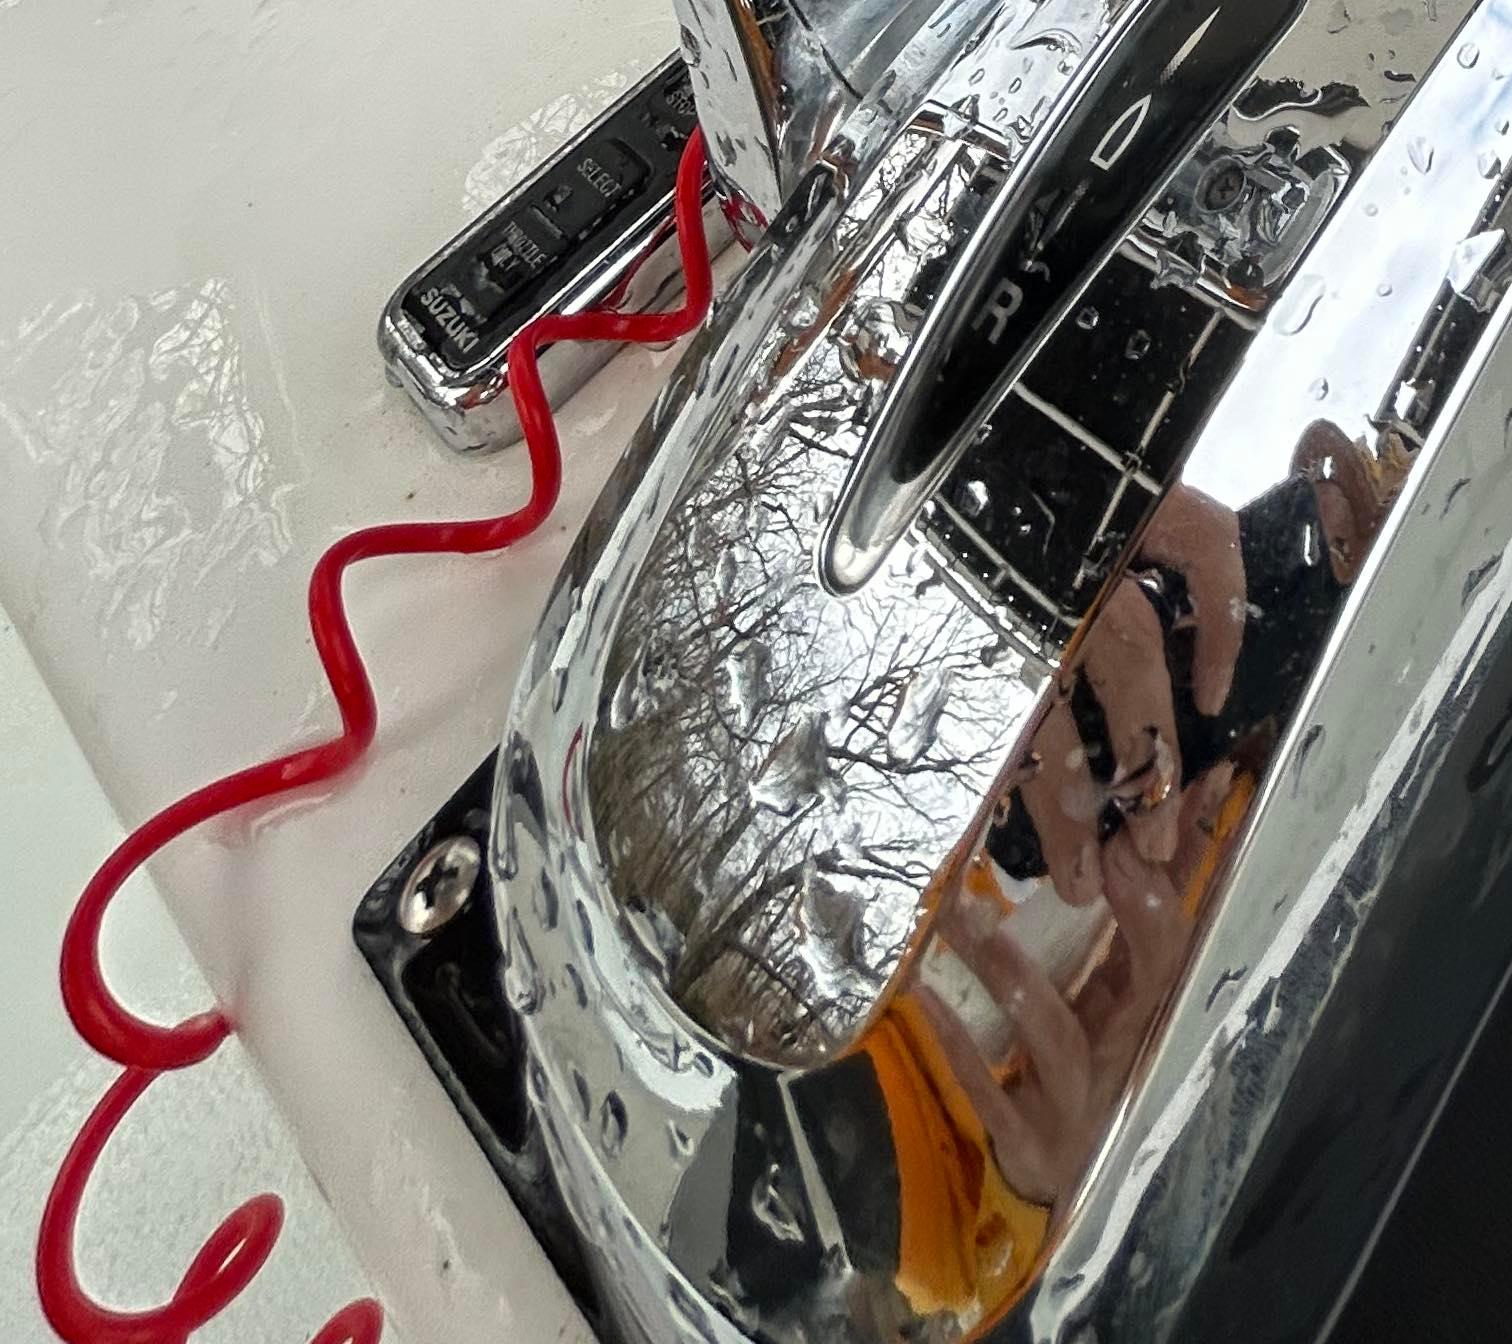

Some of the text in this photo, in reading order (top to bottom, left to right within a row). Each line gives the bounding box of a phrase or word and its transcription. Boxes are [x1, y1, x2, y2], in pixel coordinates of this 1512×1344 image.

[577, 157, 622, 198] SELECT
[420, 287, 481, 354] SUZUKI
[971, 280, 1024, 345] R
